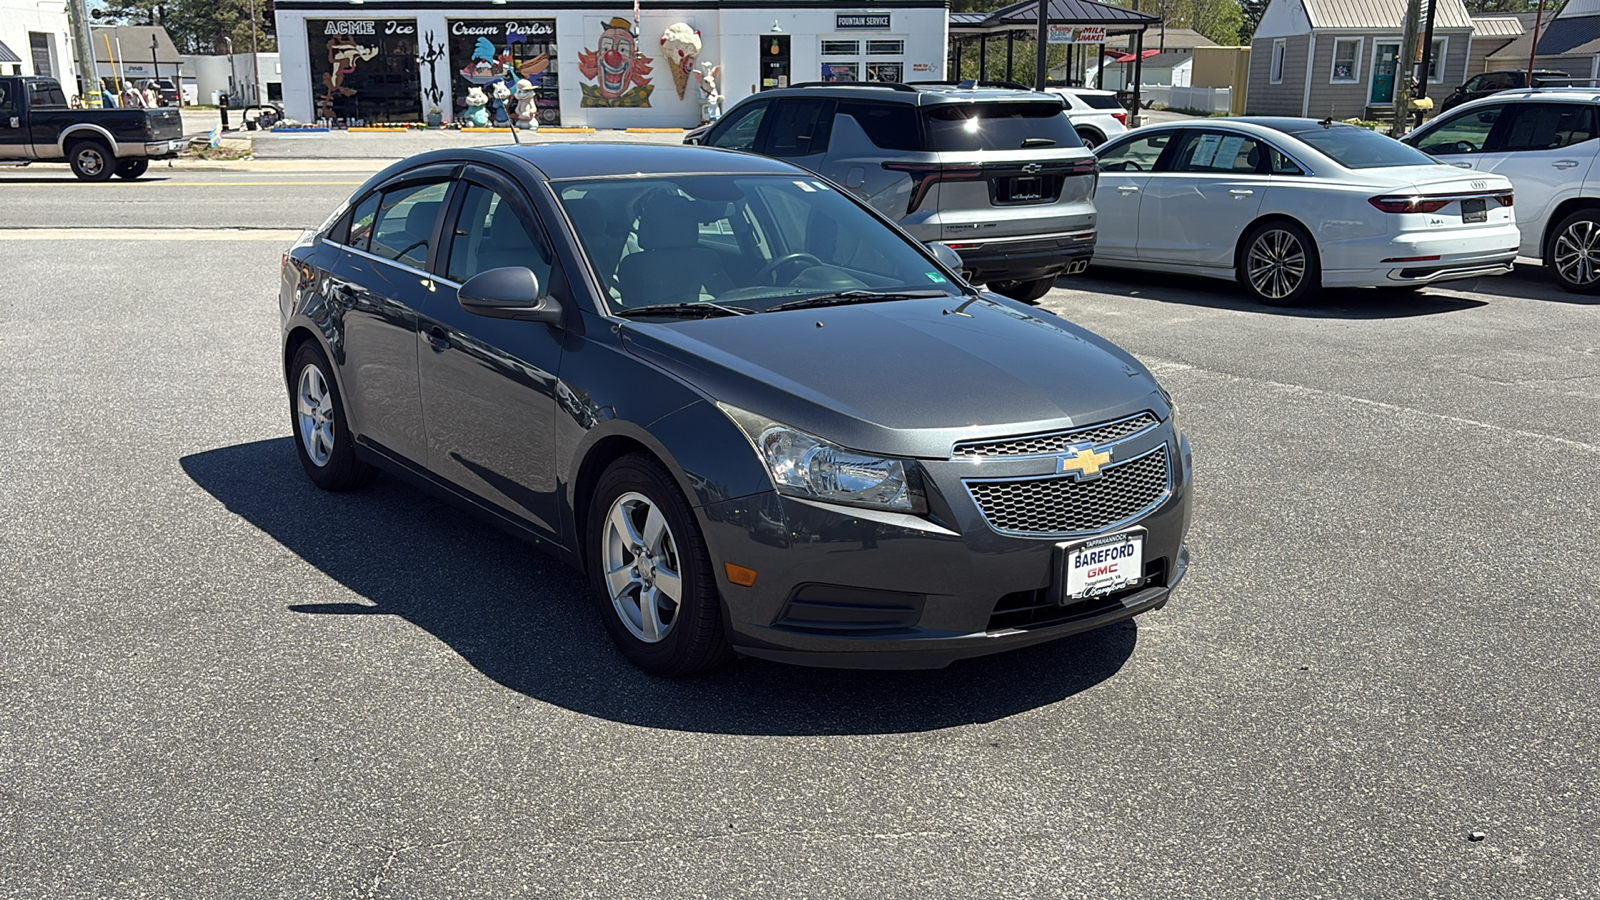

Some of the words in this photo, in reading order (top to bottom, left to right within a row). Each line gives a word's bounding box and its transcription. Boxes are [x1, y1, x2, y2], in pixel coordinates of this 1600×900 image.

[324, 20, 376, 35] ACME
[384, 20, 415, 35] Ice
[452, 21, 499, 36] Cream
[505, 21, 554, 36] Parlor
[838, 17, 865, 26] FOUNTAIN
[866, 17, 888, 25] SERVICE
[1086, 533, 1127, 547] TAPPAHANNOCK
[1075, 544, 1134, 569] BAREFORD
[1087, 563, 1118, 578] GMC
[1083, 578, 1128, 598] Bareford
